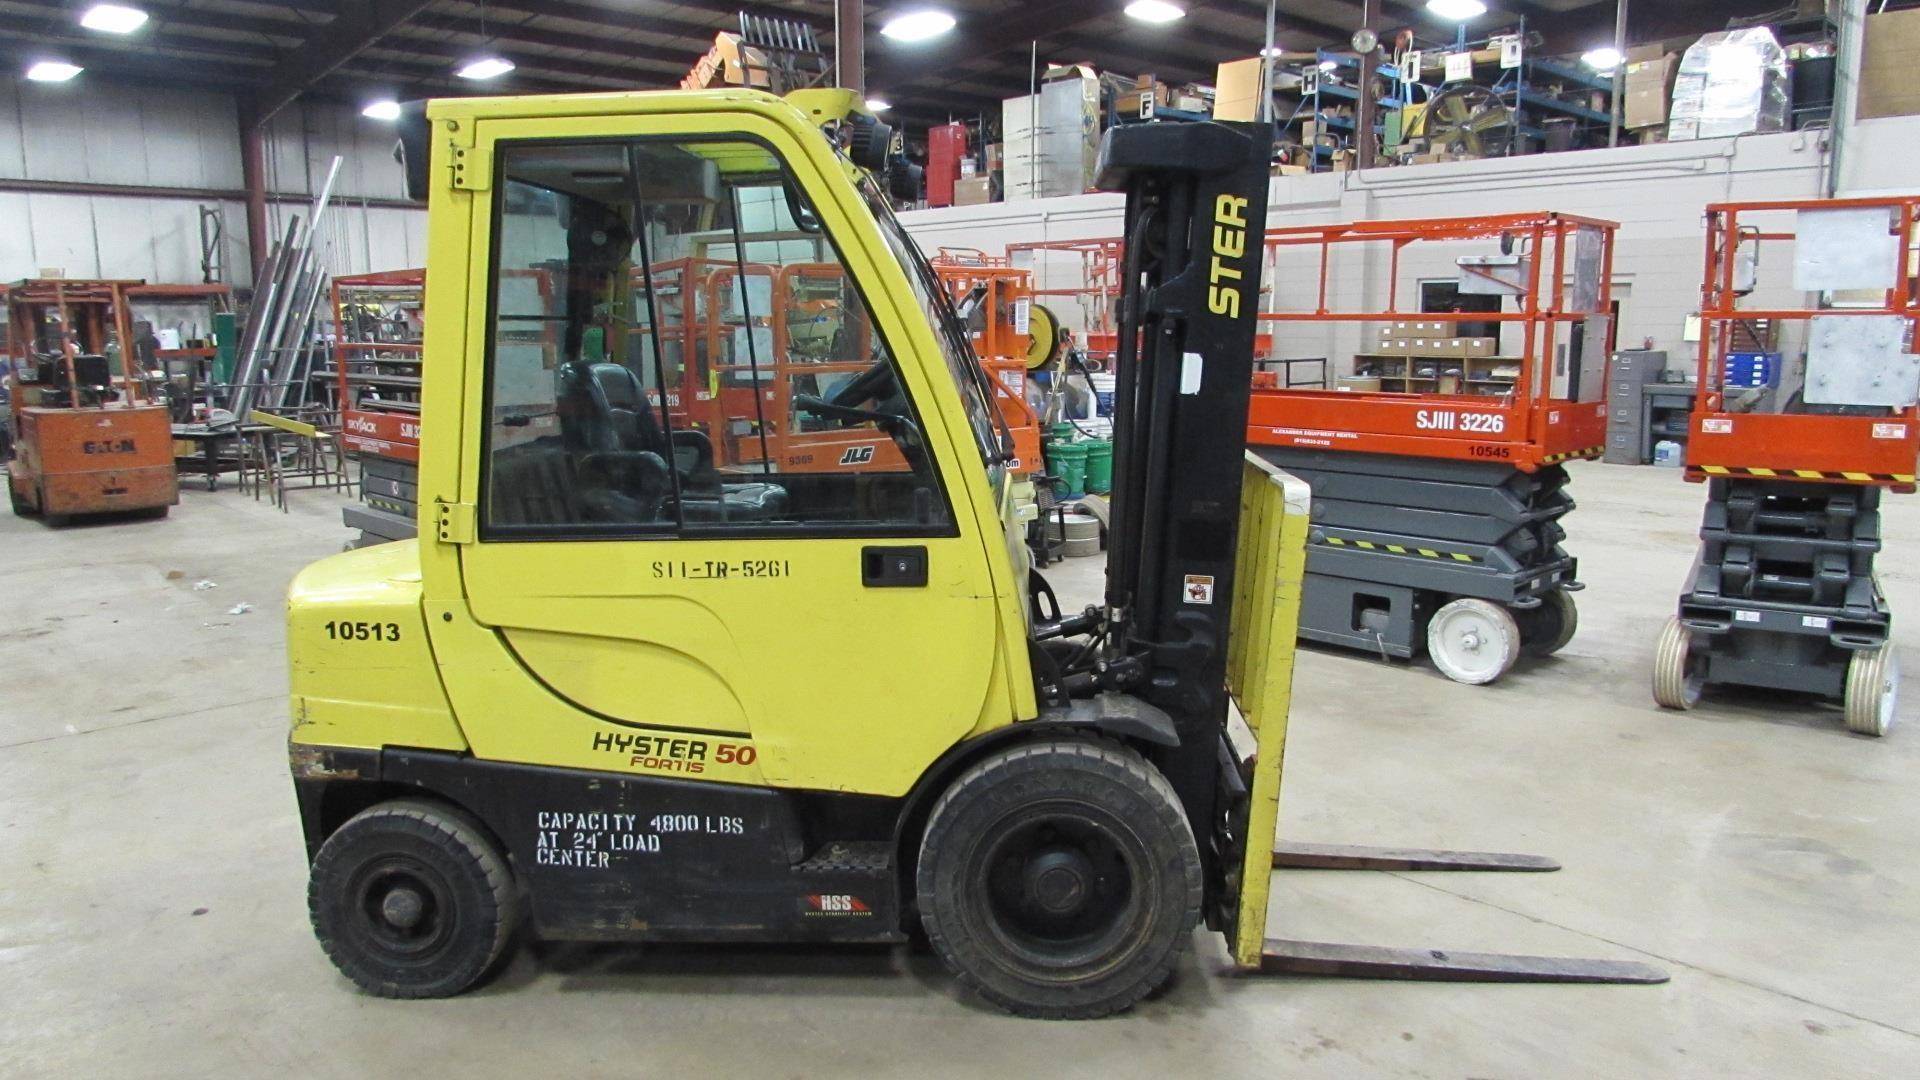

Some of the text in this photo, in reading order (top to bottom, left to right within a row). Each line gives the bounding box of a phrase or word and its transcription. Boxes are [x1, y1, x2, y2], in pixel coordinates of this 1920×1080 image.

[1142, 100, 1151, 115] F
[1208, 194, 1248, 319] STER
[1416, 410, 1504, 433] SJIII 3226
[840, 446, 874, 465] JLG
[1468, 446, 1510, 458] 10545
[325, 621, 400, 642] 10513
[592, 732, 757, 766] HYSTER 50
[630, 756, 705, 774] FORTIS
[538, 812, 636, 831] CAPACITY
[706, 816, 744, 834] LBS
[537, 831, 559, 848] AT
[610, 834, 661, 852] LOAD
[536, 848, 609, 868] CENTER
[821, 895, 852, 911] HSS
